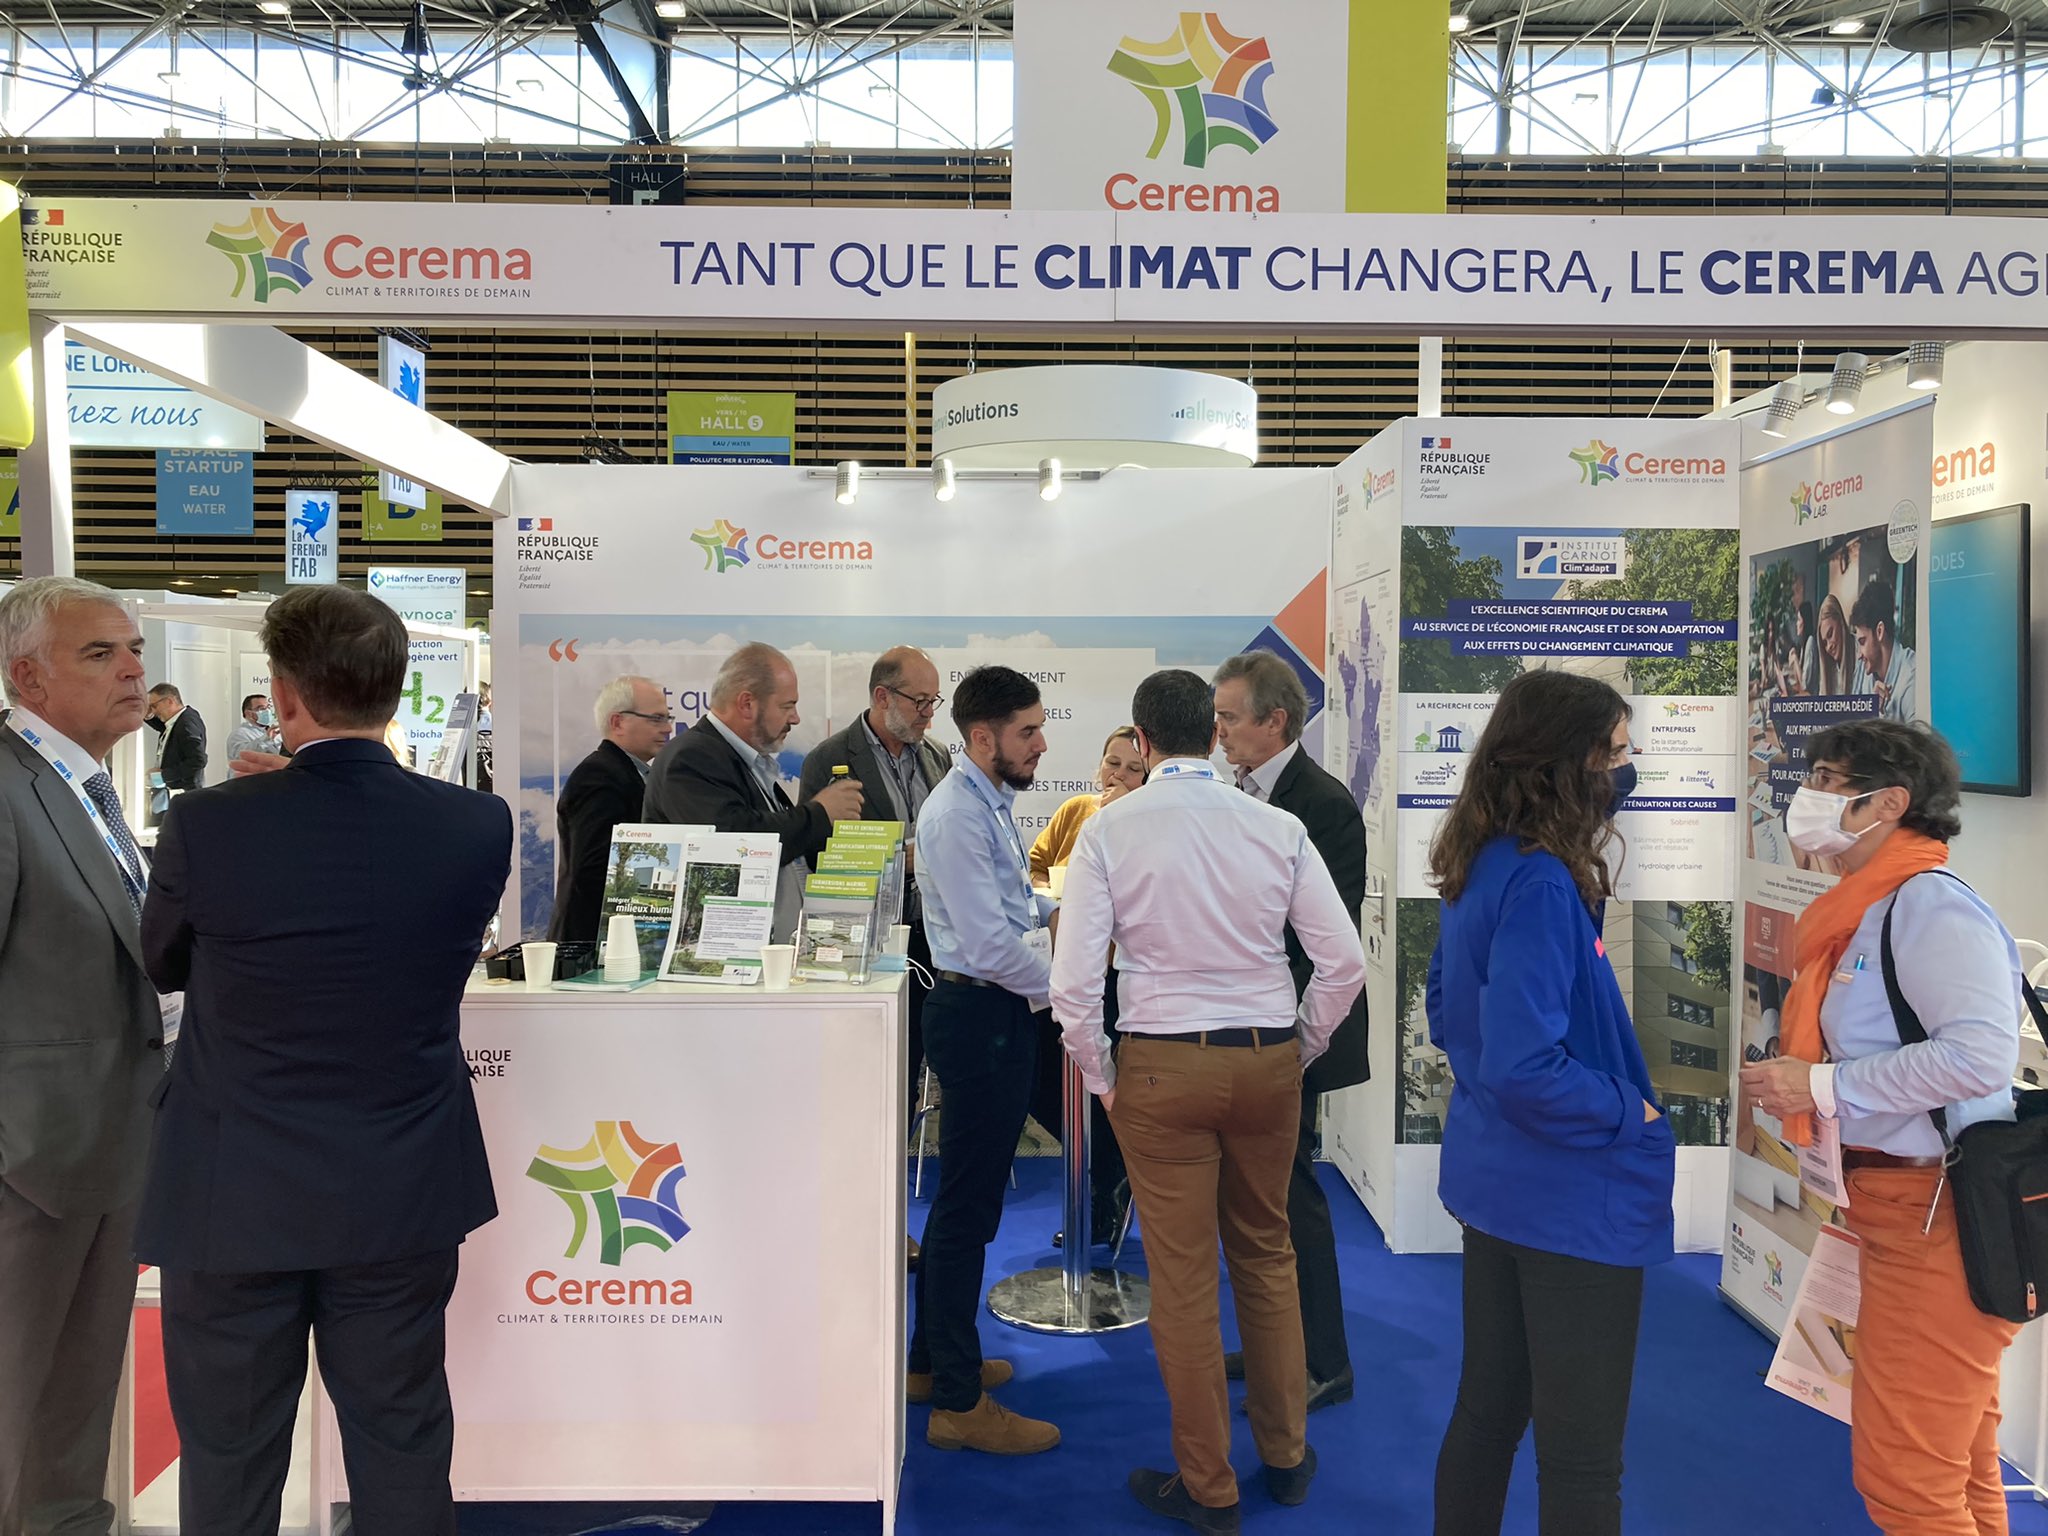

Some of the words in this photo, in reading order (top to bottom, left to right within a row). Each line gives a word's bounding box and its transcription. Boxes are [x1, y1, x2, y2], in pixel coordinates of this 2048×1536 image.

[631, 172, 664, 184] HALL
[1104, 173, 1280, 213] Cerema
[22, 229, 122, 249] RÉPUBLIQUE
[324, 234, 532, 280] Cerema
[660, 242, 815, 286] TANT
[829, 243, 947, 298] QUE
[966, 244, 1018, 289] LE
[1034, 244, 1251, 290] CLIMAT
[1265, 246, 1612, 303] CHANGERA,
[1631, 251, 1684, 295] LE
[1700, 249, 1944, 296] CEREMA
[326, 287, 368, 297] CLIMAT
[374, 287, 382, 297] &
[386, 287, 459, 298] TERRITOIRES
[465, 288, 479, 297] DE
[484, 288, 531, 298] DEMAIN
[130, 404, 203, 427] nous
[701, 417, 744, 430] HALL
[1420, 451, 1490, 464] RÉPUBLIQUE
[1625, 452, 1726, 474] Cerema
[164, 460, 244, 473] STARTUP
[1420, 465, 1485, 476] FRANÇAISE
[1932, 442, 1995, 487] ema
[189, 485, 220, 497] EAU
[1814, 474, 1863, 503] Cerema
[182, 504, 226, 514] WATER
[292, 530, 302, 543] La
[518, 533, 598, 551] RÉPUBLIQUE
[292, 543, 327, 557] FRENCH
[756, 534, 872, 560] Cerema
[1561, 542, 1617, 550] INSTITUT
[517, 549, 594, 562] FRANÇAISE
[1561, 551, 1617, 560] CARNOT
[292, 558, 317, 578] FAB
[1563, 564, 1610, 574] Clim'adapt
[386, 574, 424, 583] Haffner
[427, 574, 462, 584] Energy
[519, 572, 541, 582] Égalité
[1471, 605, 1539, 614] L'EXCELLENCE
[1541, 606, 1608, 616] SCIENTIFIQUE
[1611, 607, 1625, 615] DU
[1627, 607, 1668, 615] CEREMA
[1413, 623, 1427, 631] AU
[1429, 623, 1469, 631] SERVICE
[1487, 622, 1547, 632] L'ÉCONOMIE
[1550, 624, 1605, 634] FRANÇAISE
[1621, 625, 1634, 633] DE
[1636, 625, 1657, 633] SON
[1660, 625, 1724, 634] ADAPTATION
[1464, 641, 1485, 649] AUX
[1487, 641, 1520, 650] EFFETS
[1522, 642, 1536, 650] DU
[1539, 642, 1611, 651] CHANGEMENT
[1613, 642, 1673, 653] CLIMATIQUE
[1680, 704, 1714, 712] Cerema
[1773, 702, 1781, 712] UN
[1782, 702, 1813, 712] DISPOSITIF
[1814, 702, 1823, 712] DU
[1825, 701, 1850, 712] CEREMA
[1852, 698, 1872, 711] DÉDIÉ
[410, 729, 442, 738] biocha
[1786, 725, 1798, 735] AUX
[1792, 748, 1799, 758] ET
[1772, 769, 1788, 780] POUR
[1776, 793, 1783, 802] ET
[1639, 863, 1675, 871] Hydrologie
[616, 903, 648, 913] milieux
[525, 1270, 692, 1305] Cerema
[497, 1314, 544, 1324] CLIMAT
[550, 1314, 558, 1324] &
[564, 1314, 645, 1324] TERRITOIRES
[650, 1314, 666, 1324] DE
[672, 1314, 722, 1324] DEMAIN
